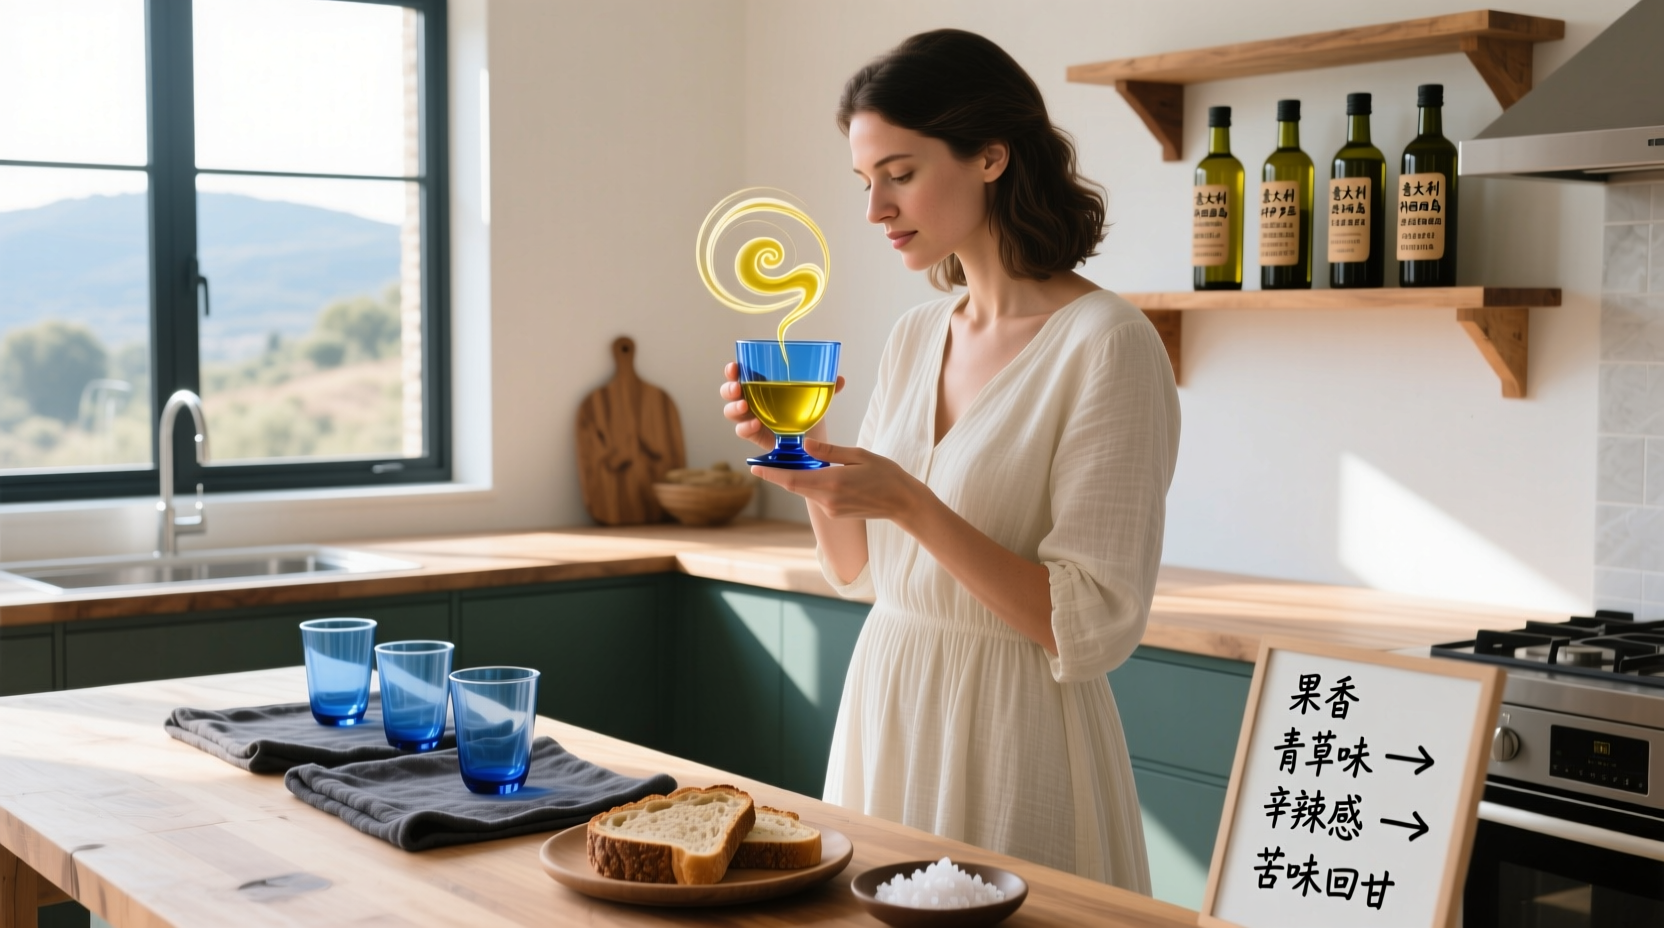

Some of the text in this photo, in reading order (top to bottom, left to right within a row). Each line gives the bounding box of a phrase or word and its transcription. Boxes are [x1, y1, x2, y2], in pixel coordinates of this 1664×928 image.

[1289, 673, 1360, 720] 果香
[1274, 726, 1373, 779] 青草味
[1263, 785, 1363, 842] 辛辣感
[1253, 845, 1396, 911] 苦味回甘
